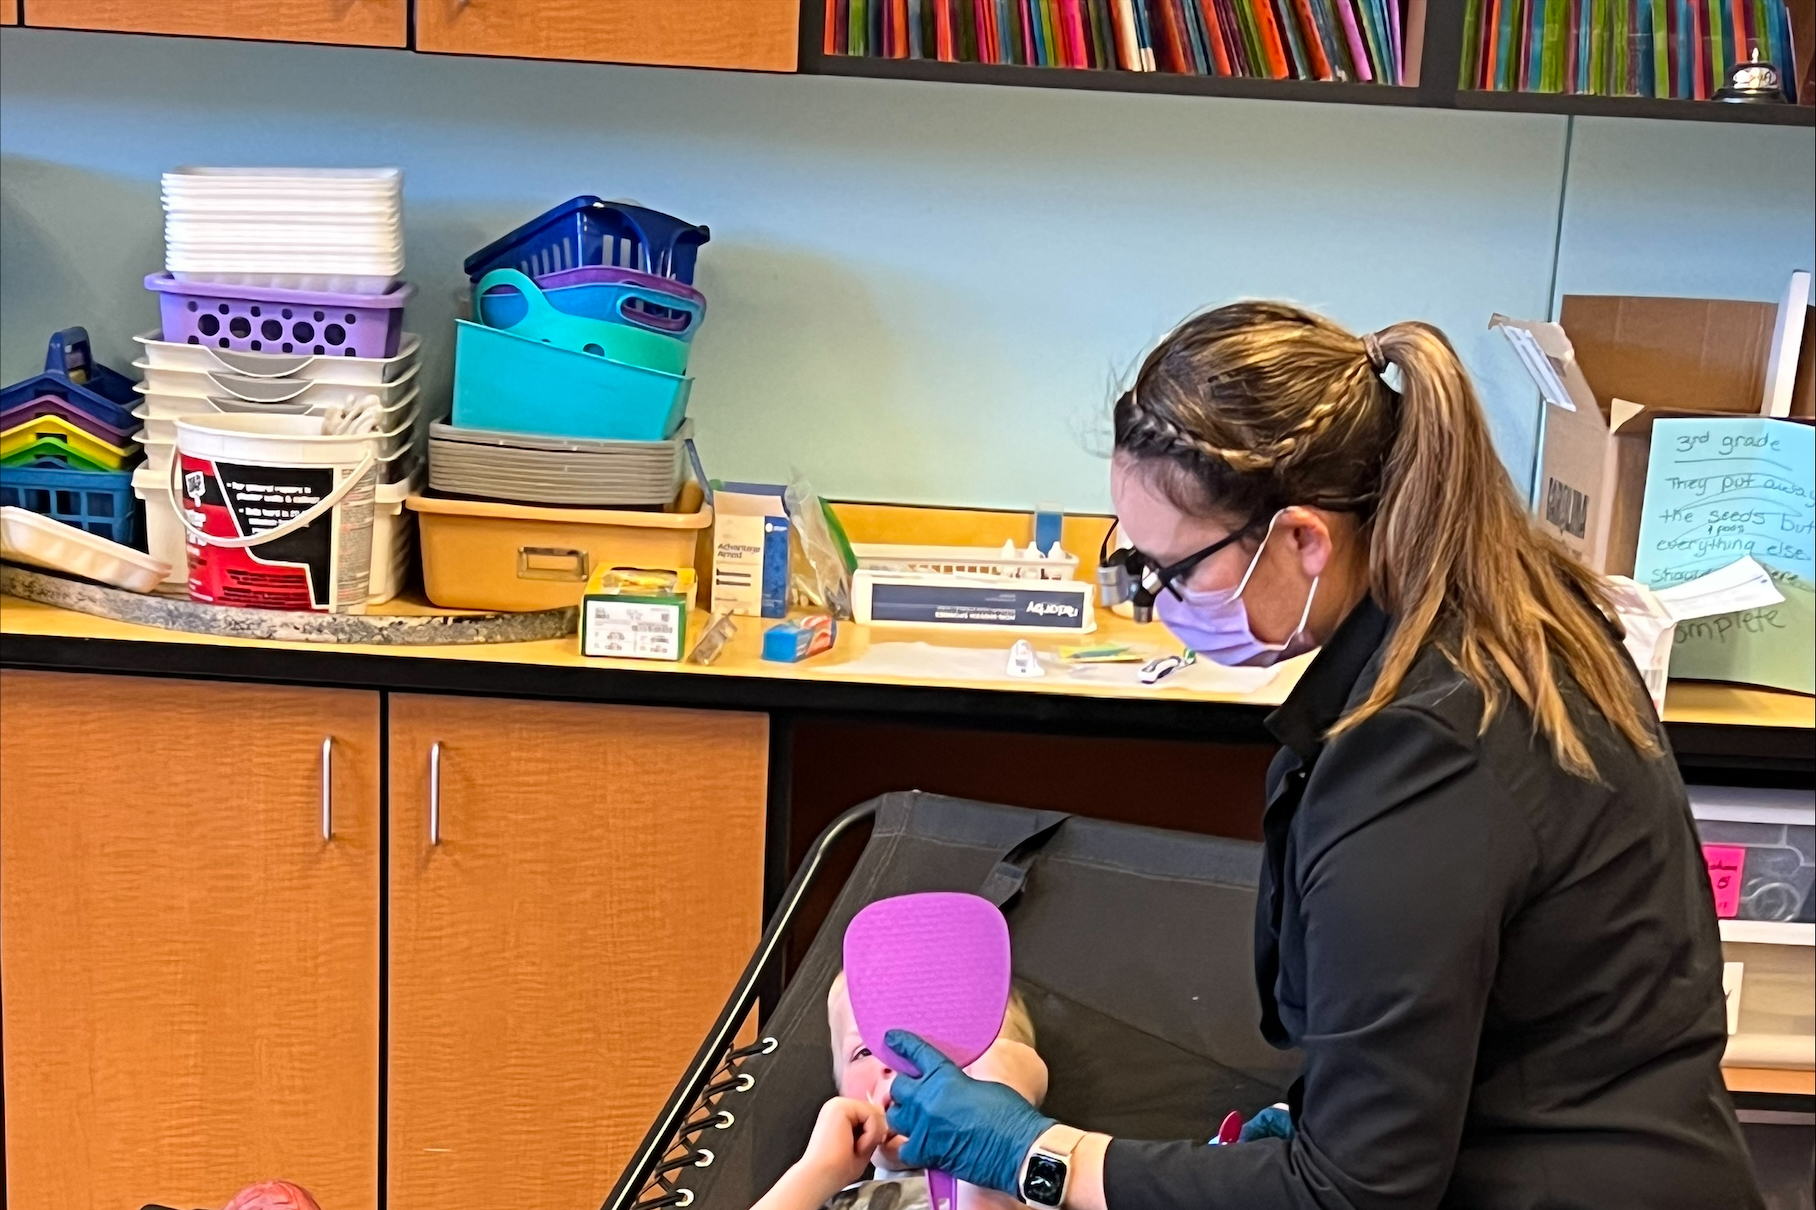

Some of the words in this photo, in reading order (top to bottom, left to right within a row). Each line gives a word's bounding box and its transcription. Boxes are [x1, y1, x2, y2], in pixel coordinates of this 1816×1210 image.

[1676, 431, 1710, 452] 3rd
[1718, 432, 1781, 455] grade
[1665, 477, 1708, 496] They
[1721, 474, 1755, 493] put
[1659, 508, 1693, 523] the
[1708, 507, 1766, 525] seeds
[1780, 513, 1815, 535] but
[1656, 538, 1756, 557] everything
[1673, 607, 1786, 644] omplete
